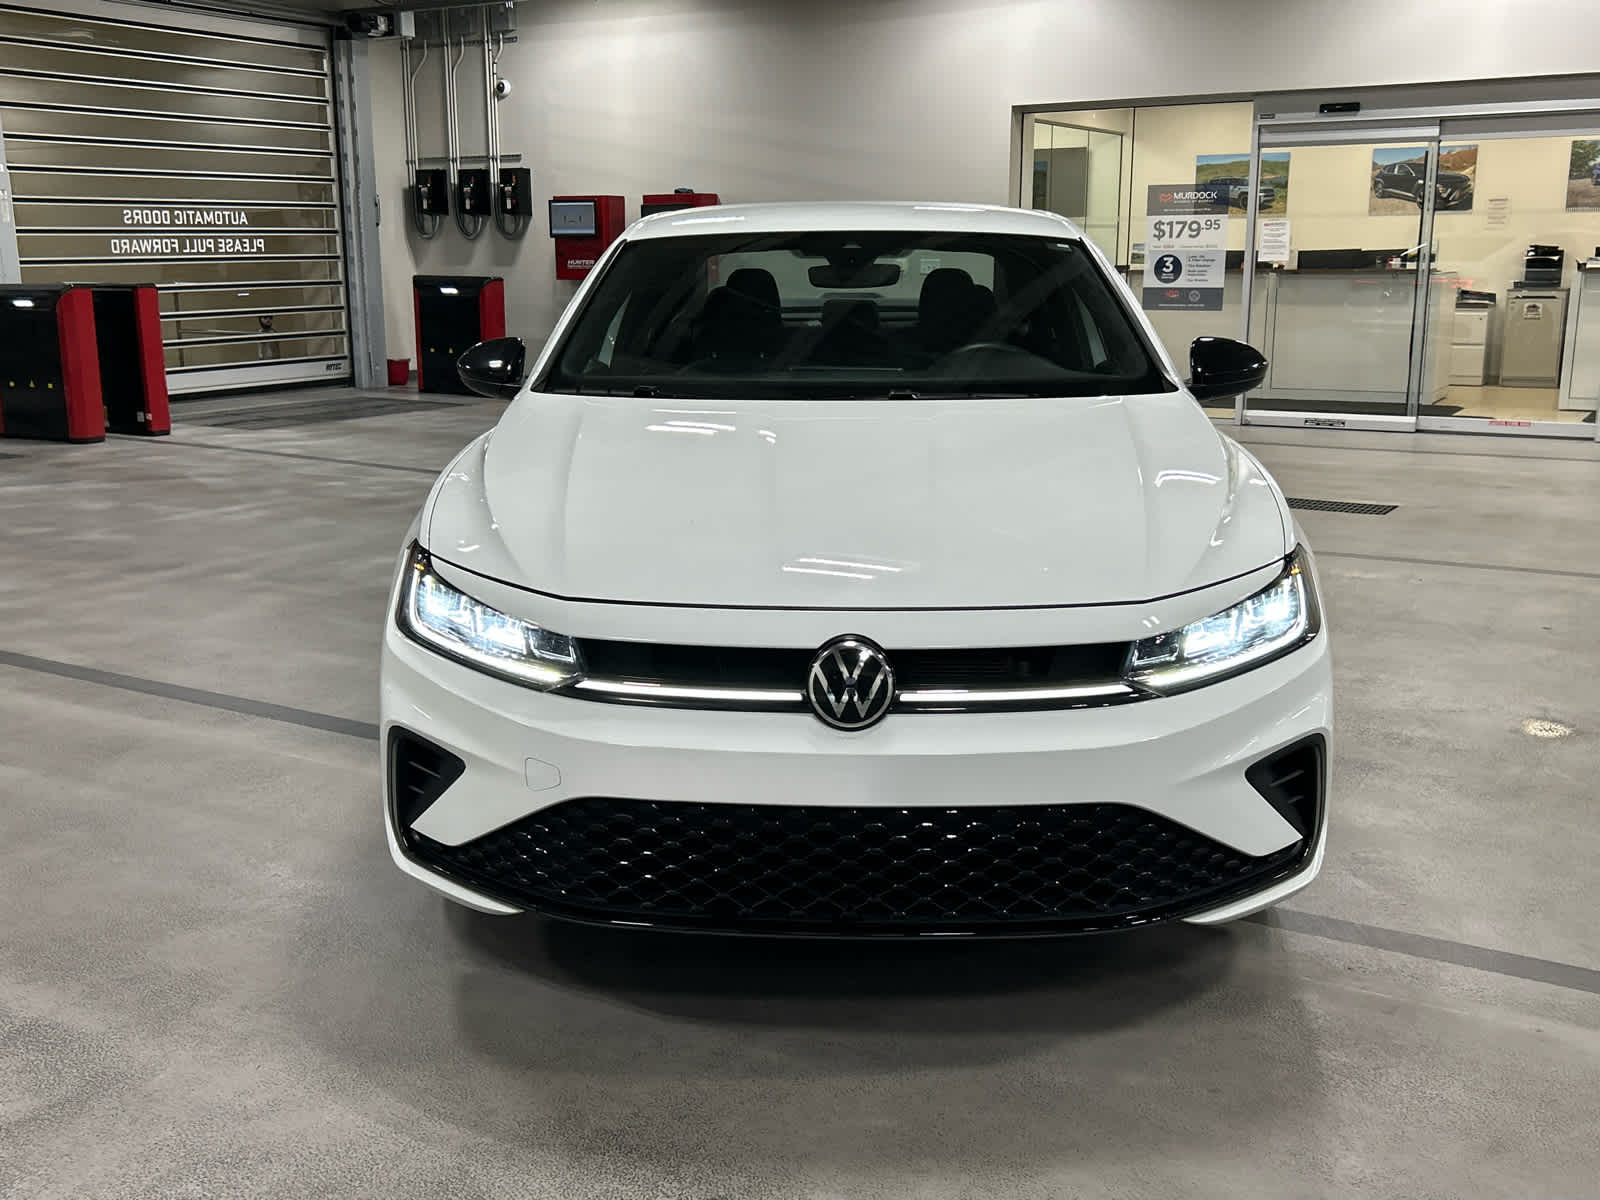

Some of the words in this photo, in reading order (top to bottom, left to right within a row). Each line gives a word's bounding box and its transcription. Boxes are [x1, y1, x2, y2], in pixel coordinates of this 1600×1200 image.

[1173, 191, 1218, 200] MURDOCK
[1153, 219, 1221, 241] $179.95
[1162, 256, 1174, 273] 3
